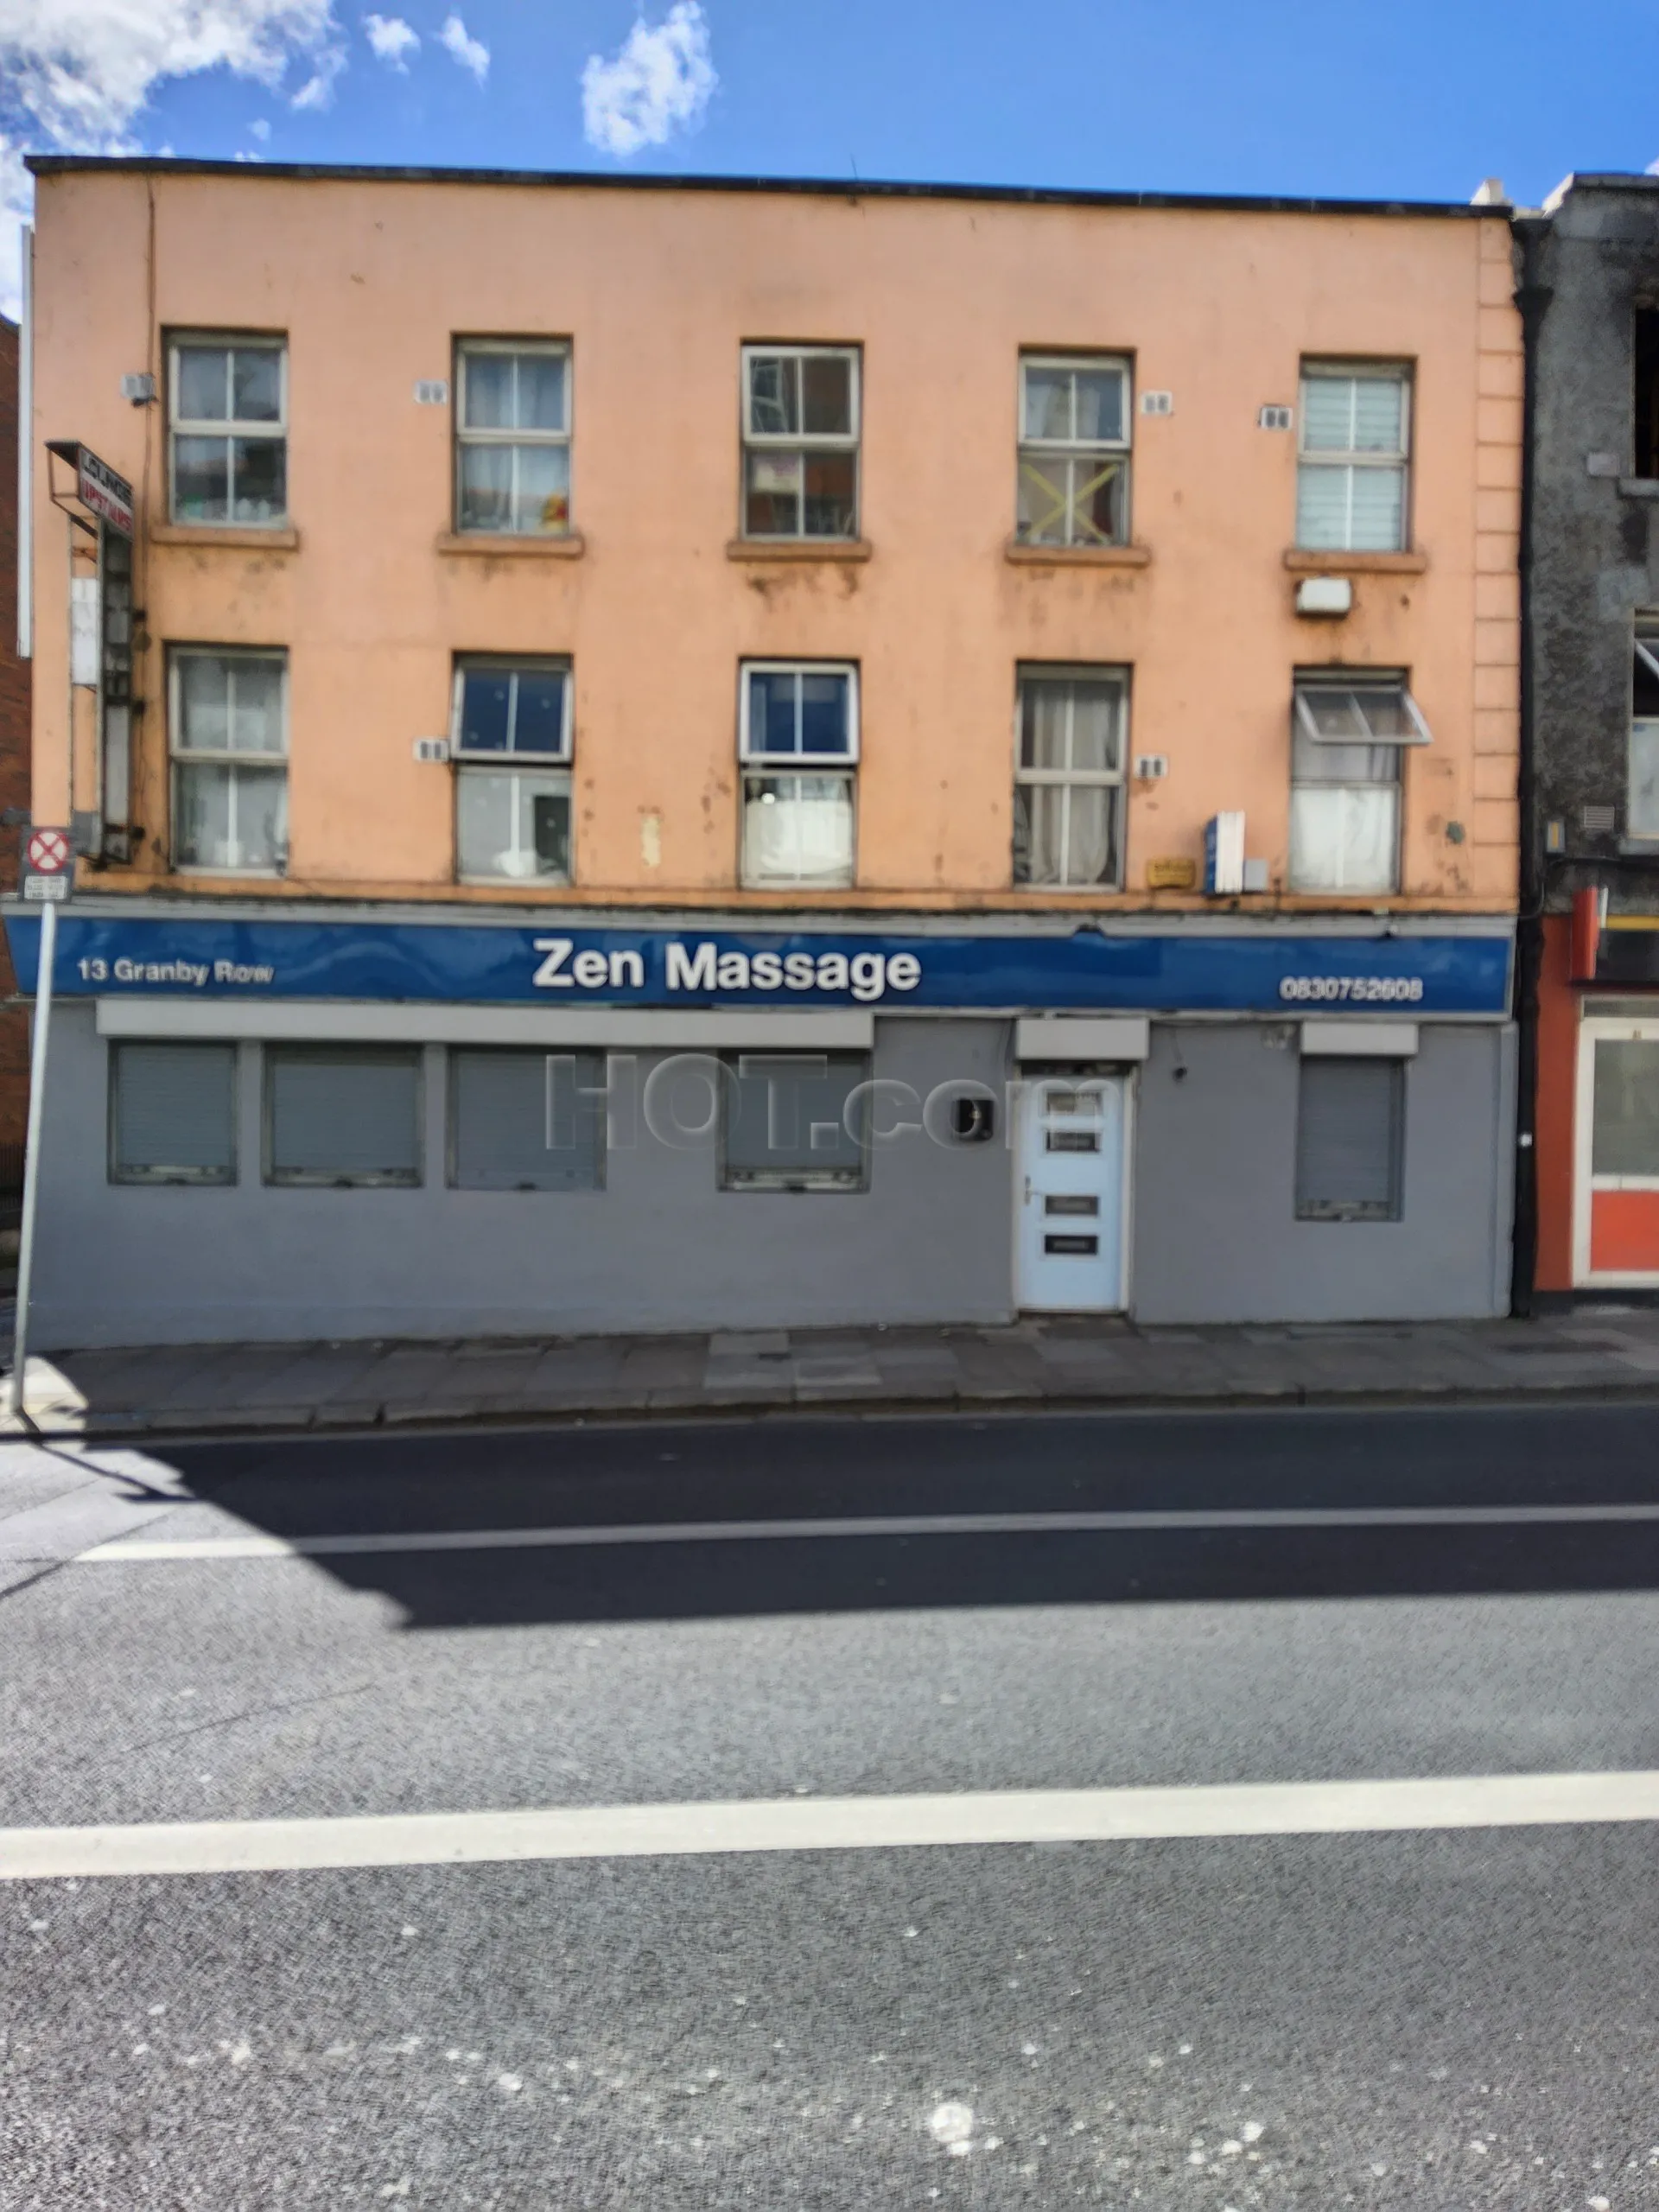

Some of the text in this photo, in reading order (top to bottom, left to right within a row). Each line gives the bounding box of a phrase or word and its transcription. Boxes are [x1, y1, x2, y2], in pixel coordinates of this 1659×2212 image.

[79, 957, 274, 987] 13 Granby Row
[532, 938, 922, 1001] Zen Massage
